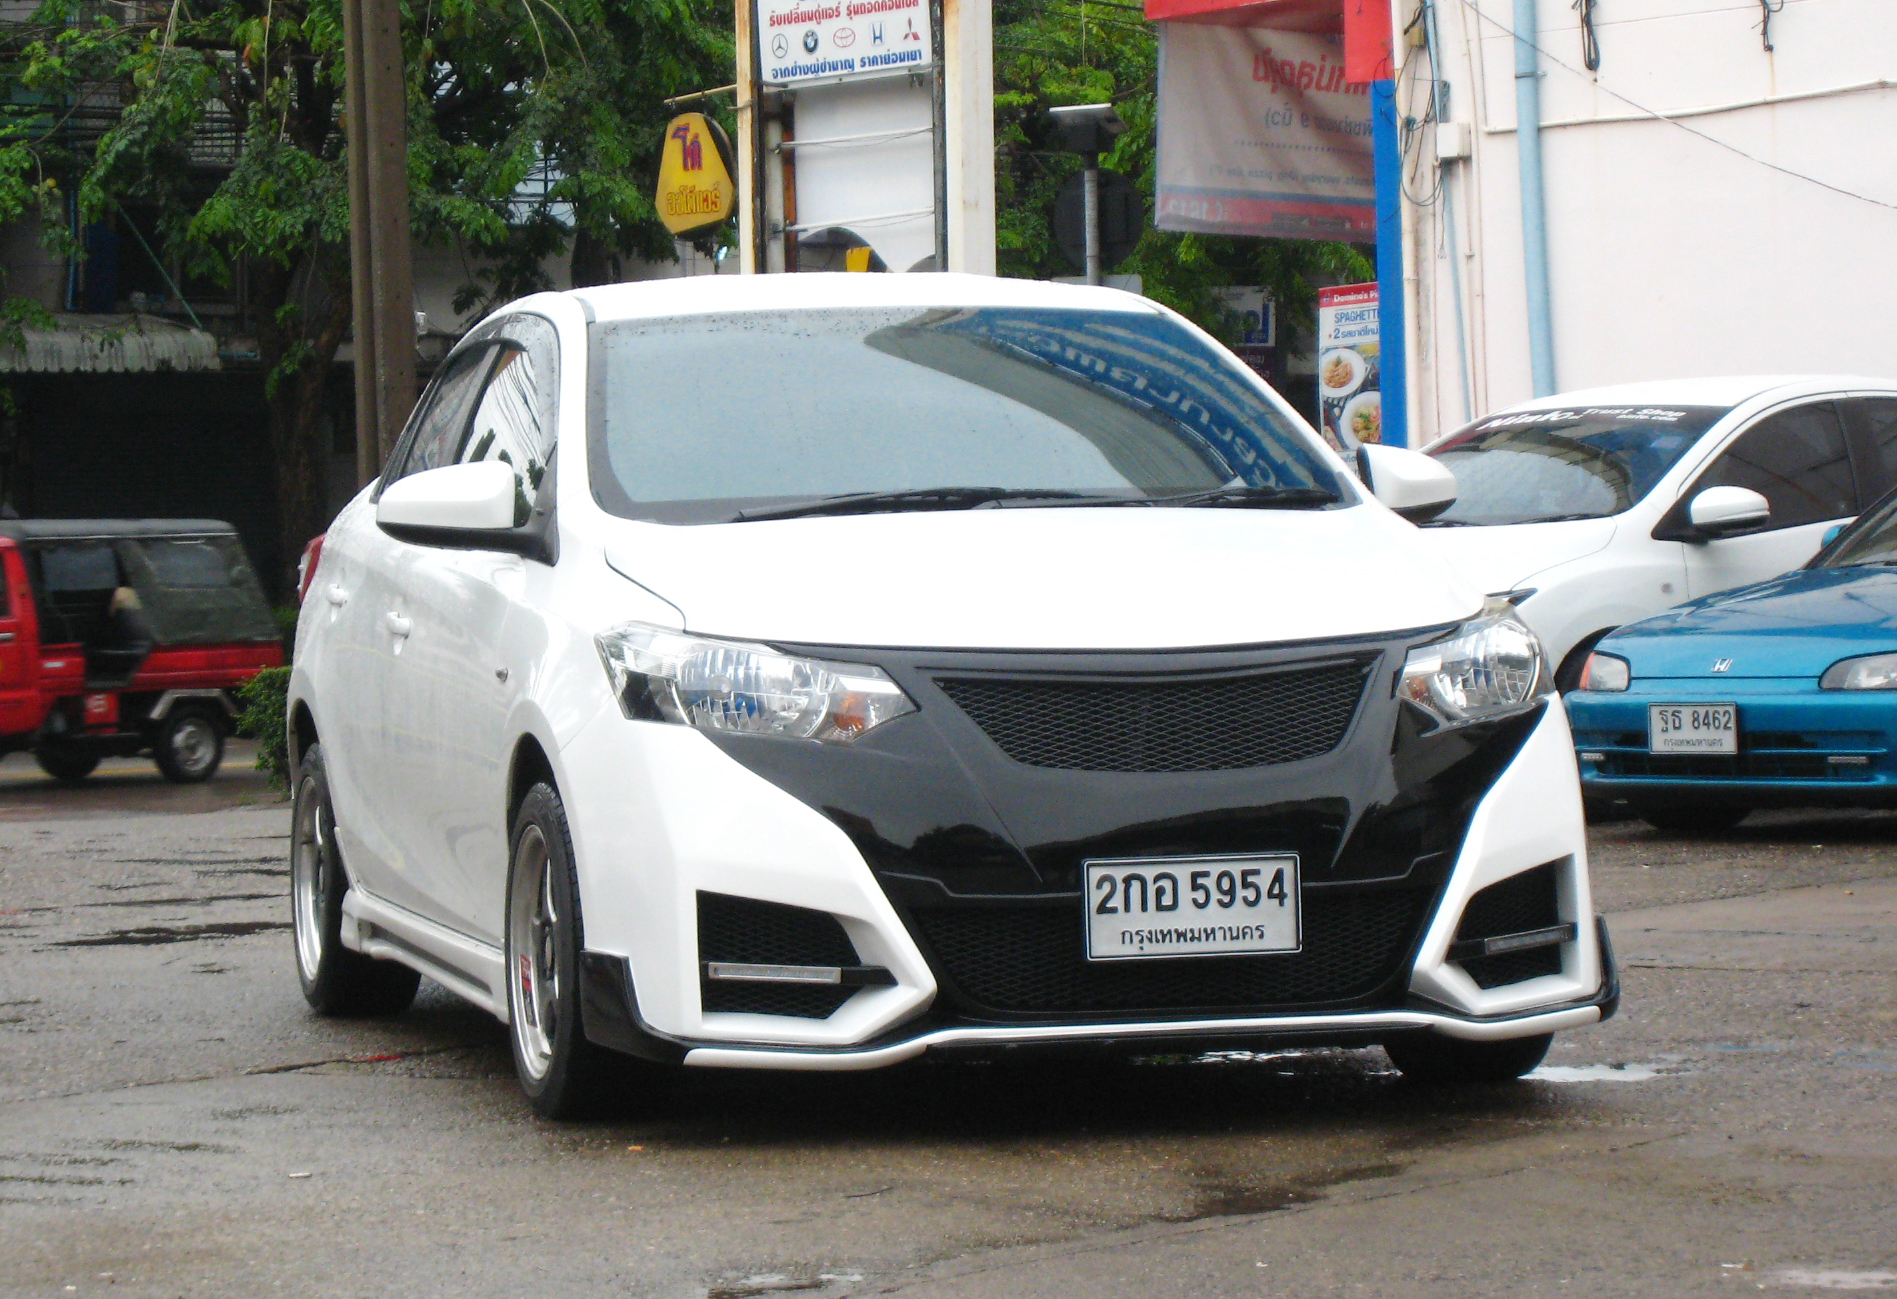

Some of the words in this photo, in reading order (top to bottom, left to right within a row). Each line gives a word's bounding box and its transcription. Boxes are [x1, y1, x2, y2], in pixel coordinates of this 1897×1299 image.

[860, 49, 922, 68] ราคาย่อมเยา
[1333, 290, 1369, 302] Domino's
[1658, 709, 1683, 733] ฐธ
[1691, 709, 1733, 731] 8462
[1095, 871, 1179, 915] 2กอ
[1189, 866, 1289, 910] 5954
[1121, 923, 1266, 951] กรุงเทพมหานคร
